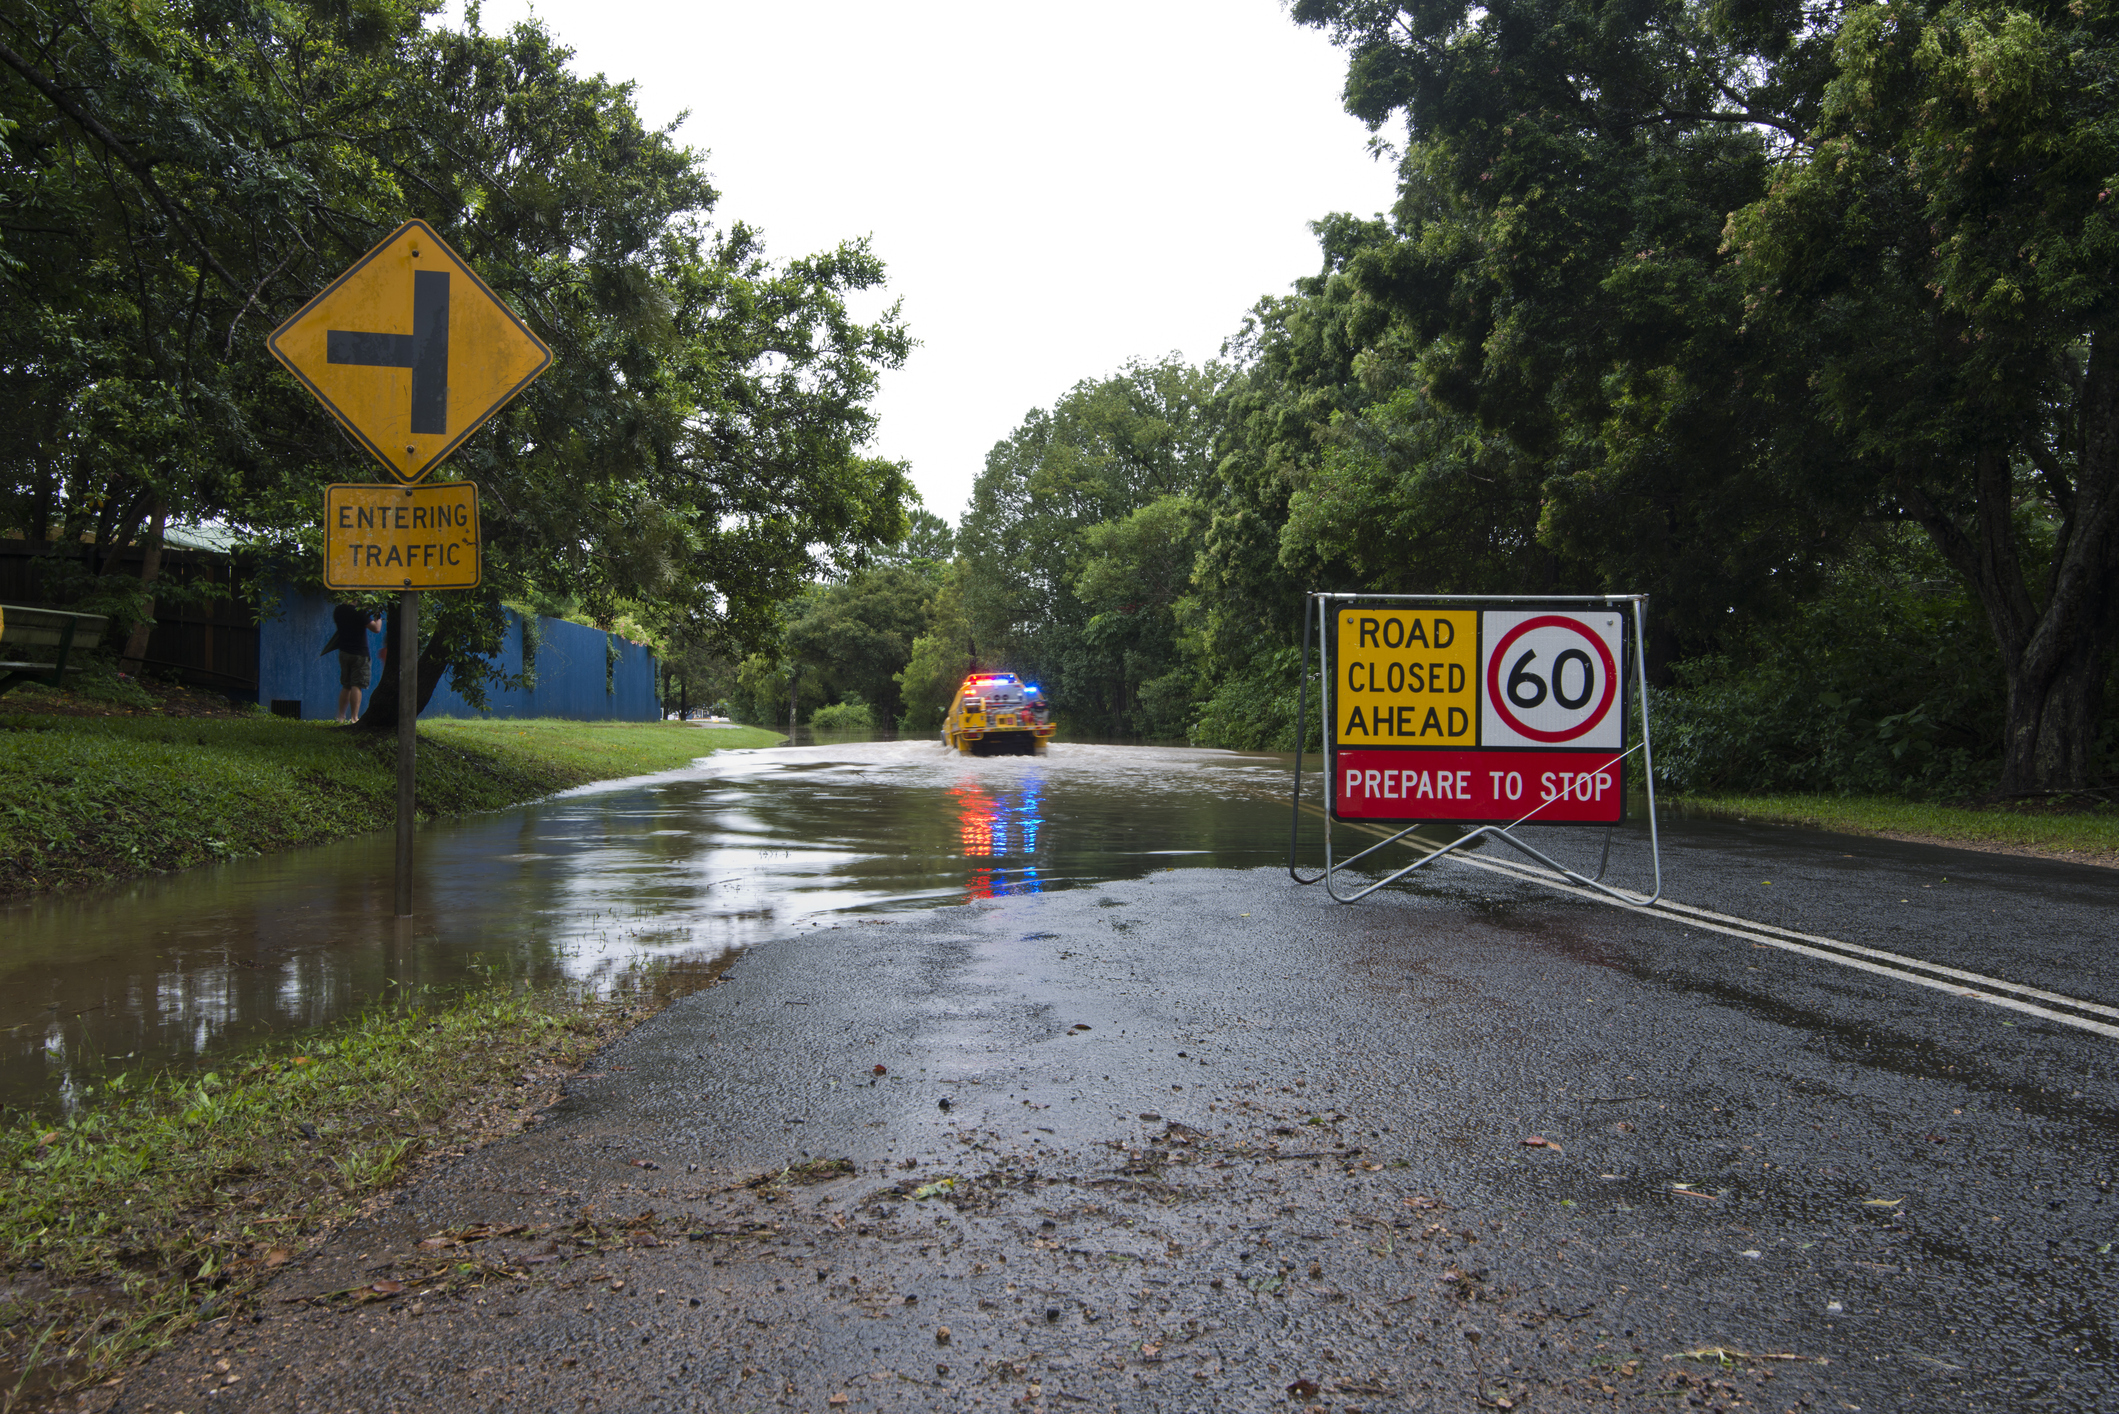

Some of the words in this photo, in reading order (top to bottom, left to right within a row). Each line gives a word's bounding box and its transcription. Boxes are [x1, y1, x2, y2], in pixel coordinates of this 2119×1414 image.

[339, 503, 468, 529] ENTERING
[349, 543, 461, 567] TRAFFIC
[1359, 618, 1455, 649] ROAD
[1348, 662, 1466, 694] CLOSED
[1506, 648, 1595, 710] 60
[1344, 706, 1469, 738] AHEAD
[1345, 769, 1472, 800] PREPARE
[1489, 771, 1523, 801] TO
[1540, 772, 1612, 802] STOP
